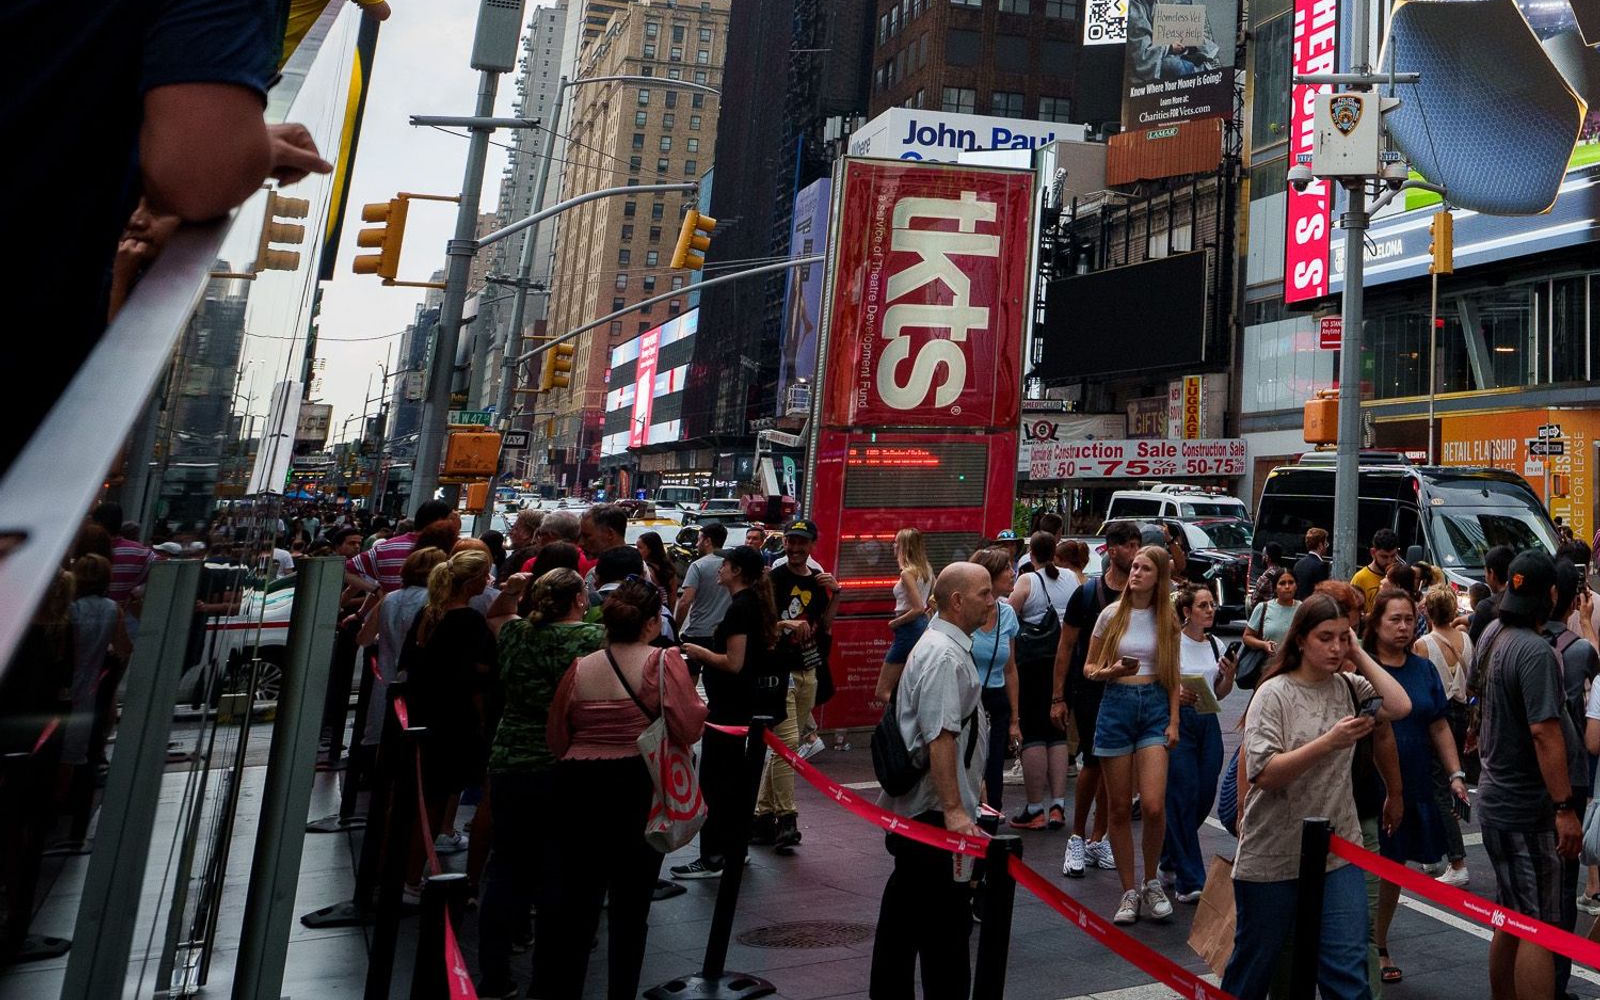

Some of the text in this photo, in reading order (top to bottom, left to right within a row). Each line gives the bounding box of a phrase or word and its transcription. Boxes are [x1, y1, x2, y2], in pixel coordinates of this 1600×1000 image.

[1130, 86, 1146, 97] Know
[1146, 83, 1164, 94] Where
[1164, 80, 1177, 91] Your
[1177, 78, 1196, 89] Money
[1202, 72, 1223, 85] Going?
[873, 203, 886, 244] service
[873, 246, 882, 256] of
[1363, 239, 1403, 262] ARCELONA
[868, 259, 883, 302] Theatre
[877, 190, 1000, 410] tkts
[861, 304, 878, 378] Development
[1321, 328, 1340, 336] Anytime
[858, 380, 871, 409] Fund
[471, 413, 481, 425] 47
[1135, 409, 1166, 434] GIFTS
[510, 435, 521, 443] AY
[1054, 442, 1123, 461] Construction
[1137, 441, 1177, 458] Sale
[1182, 442, 1228, 458] Construction
[1229, 440, 1245, 457] Sale
[1443, 438, 1517, 462] RETAIL FLAGSHIP
[1151, 467, 1177, 476] OFF
[1574, 431, 1585, 541] ACE FOR LEASE
